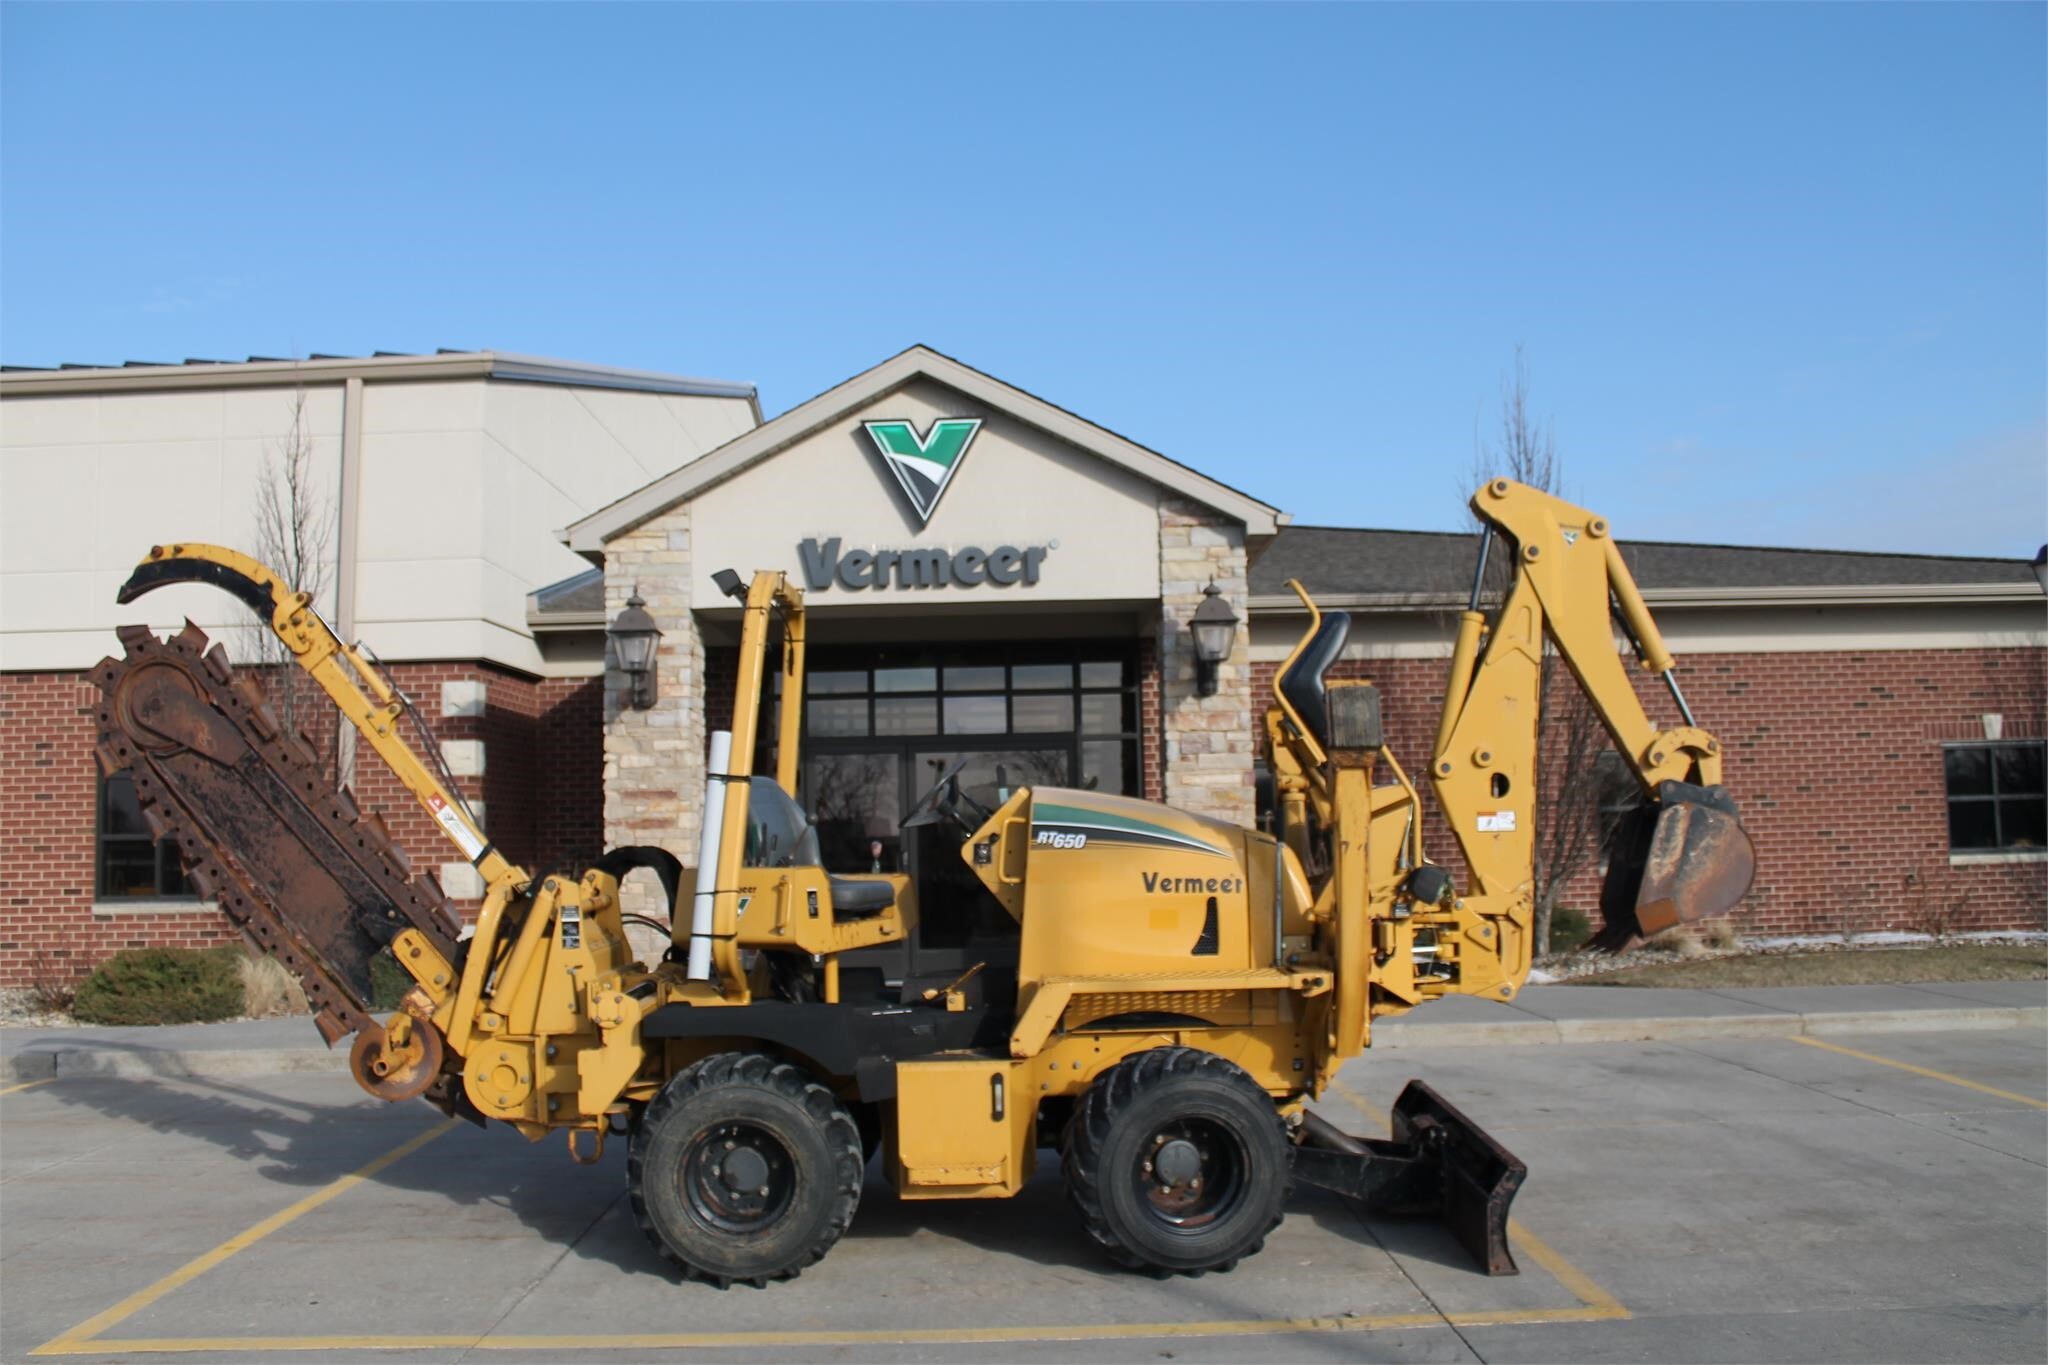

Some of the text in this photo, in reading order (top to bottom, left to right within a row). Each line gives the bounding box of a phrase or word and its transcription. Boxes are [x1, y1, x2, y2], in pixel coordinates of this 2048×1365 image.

[797, 537, 1047, 590] Vermeer
[1036, 830, 1087, 849] RT650
[1142, 872, 1243, 894] Vermeer
